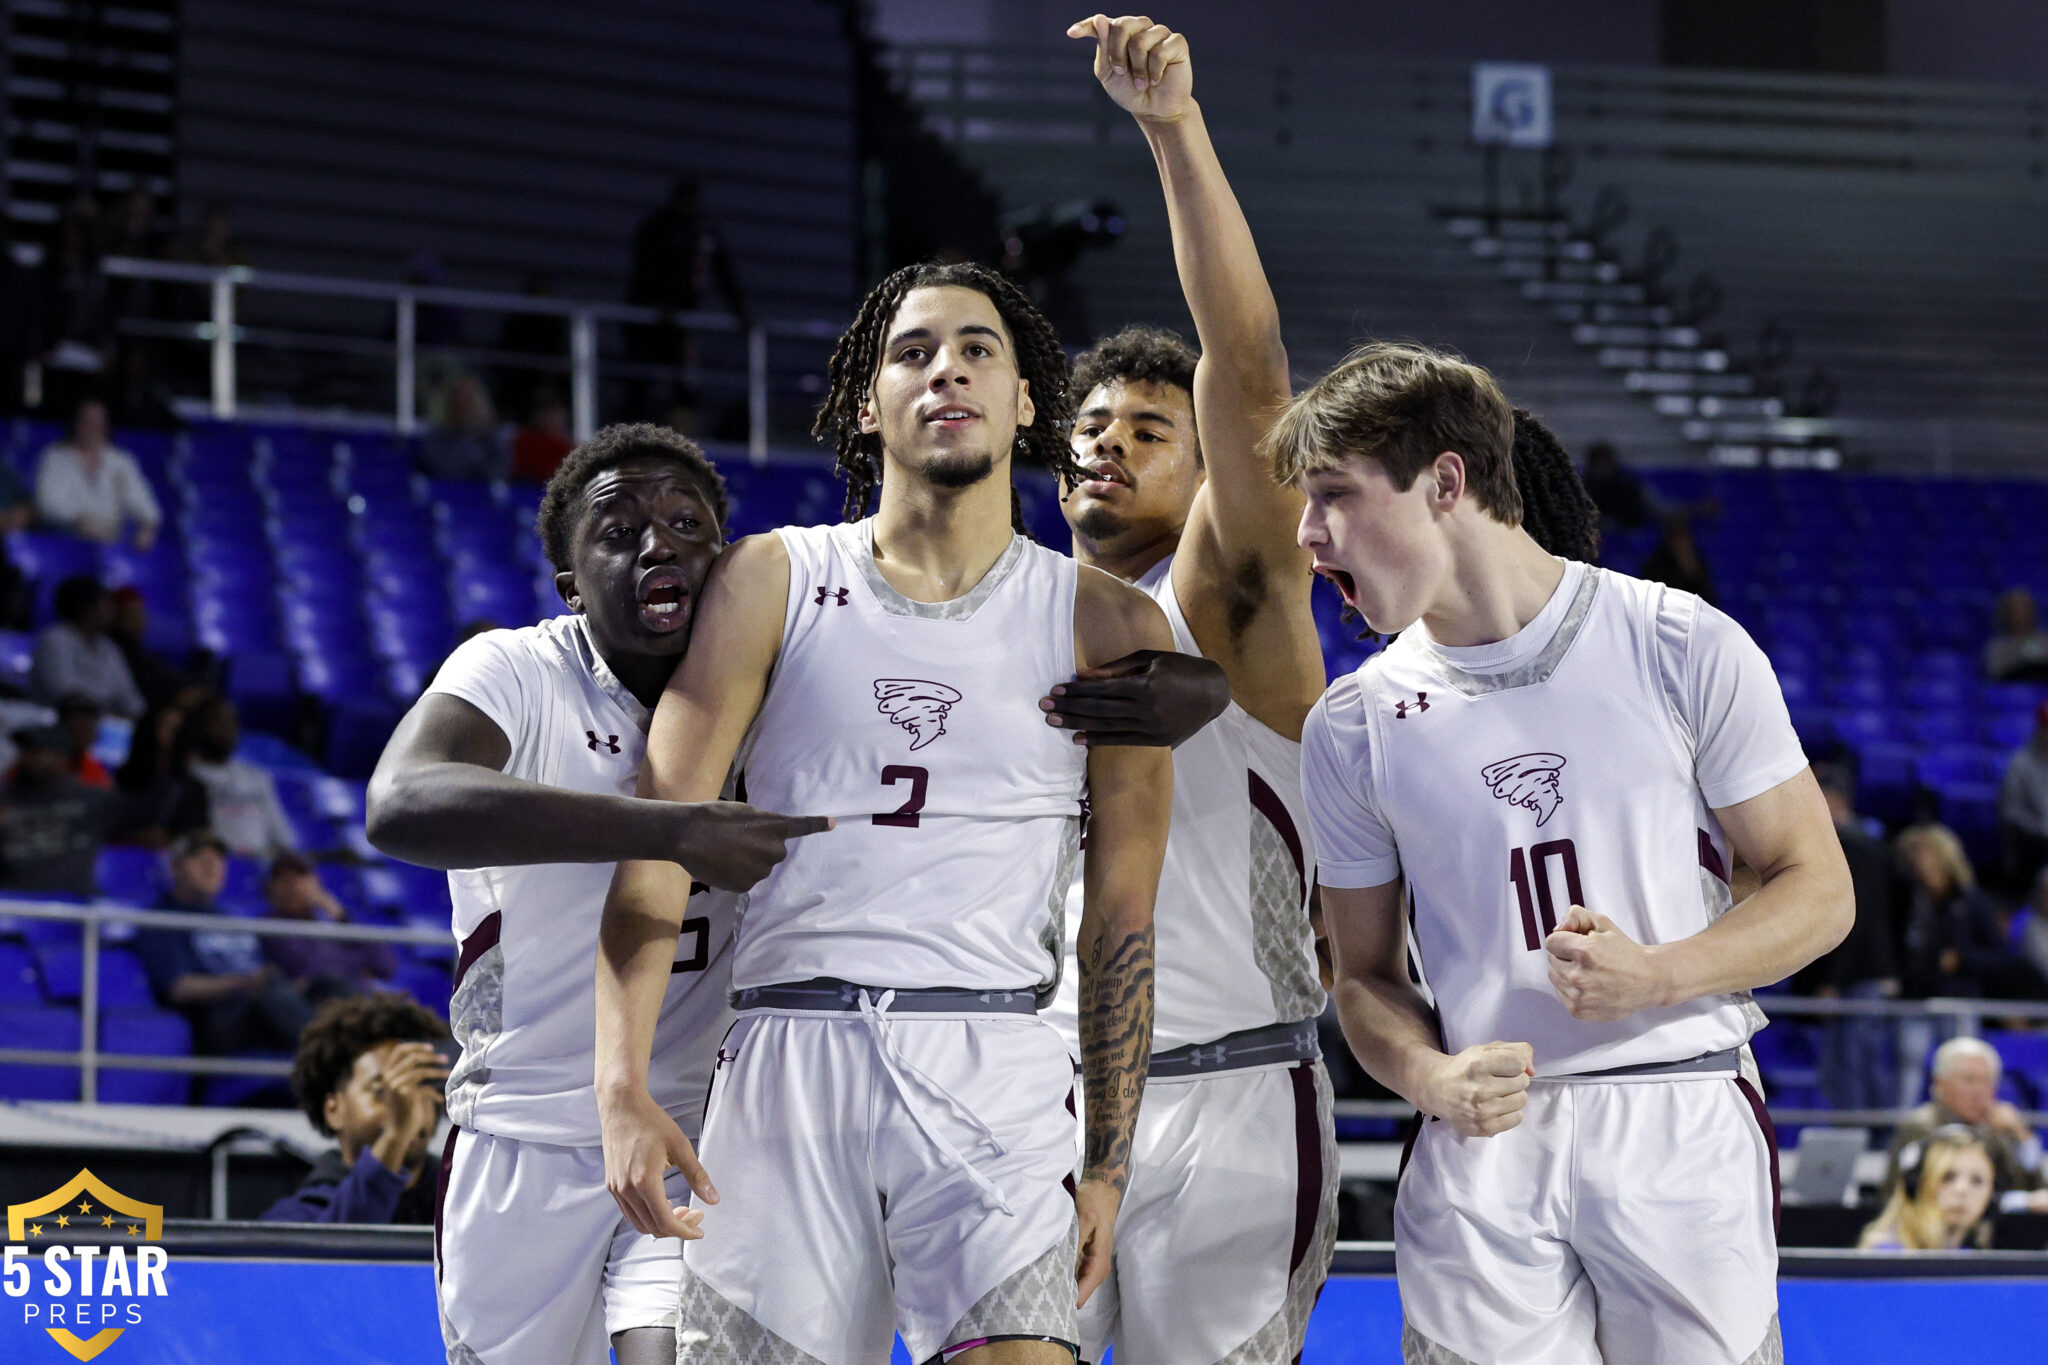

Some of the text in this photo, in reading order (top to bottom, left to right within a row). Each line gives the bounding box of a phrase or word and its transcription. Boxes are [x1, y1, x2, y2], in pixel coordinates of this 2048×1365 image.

[1491, 80, 1534, 129] G
[872, 765, 929, 828] 2
[1510, 839, 1585, 951] 10
[1122, 1077, 1136, 1098] do
